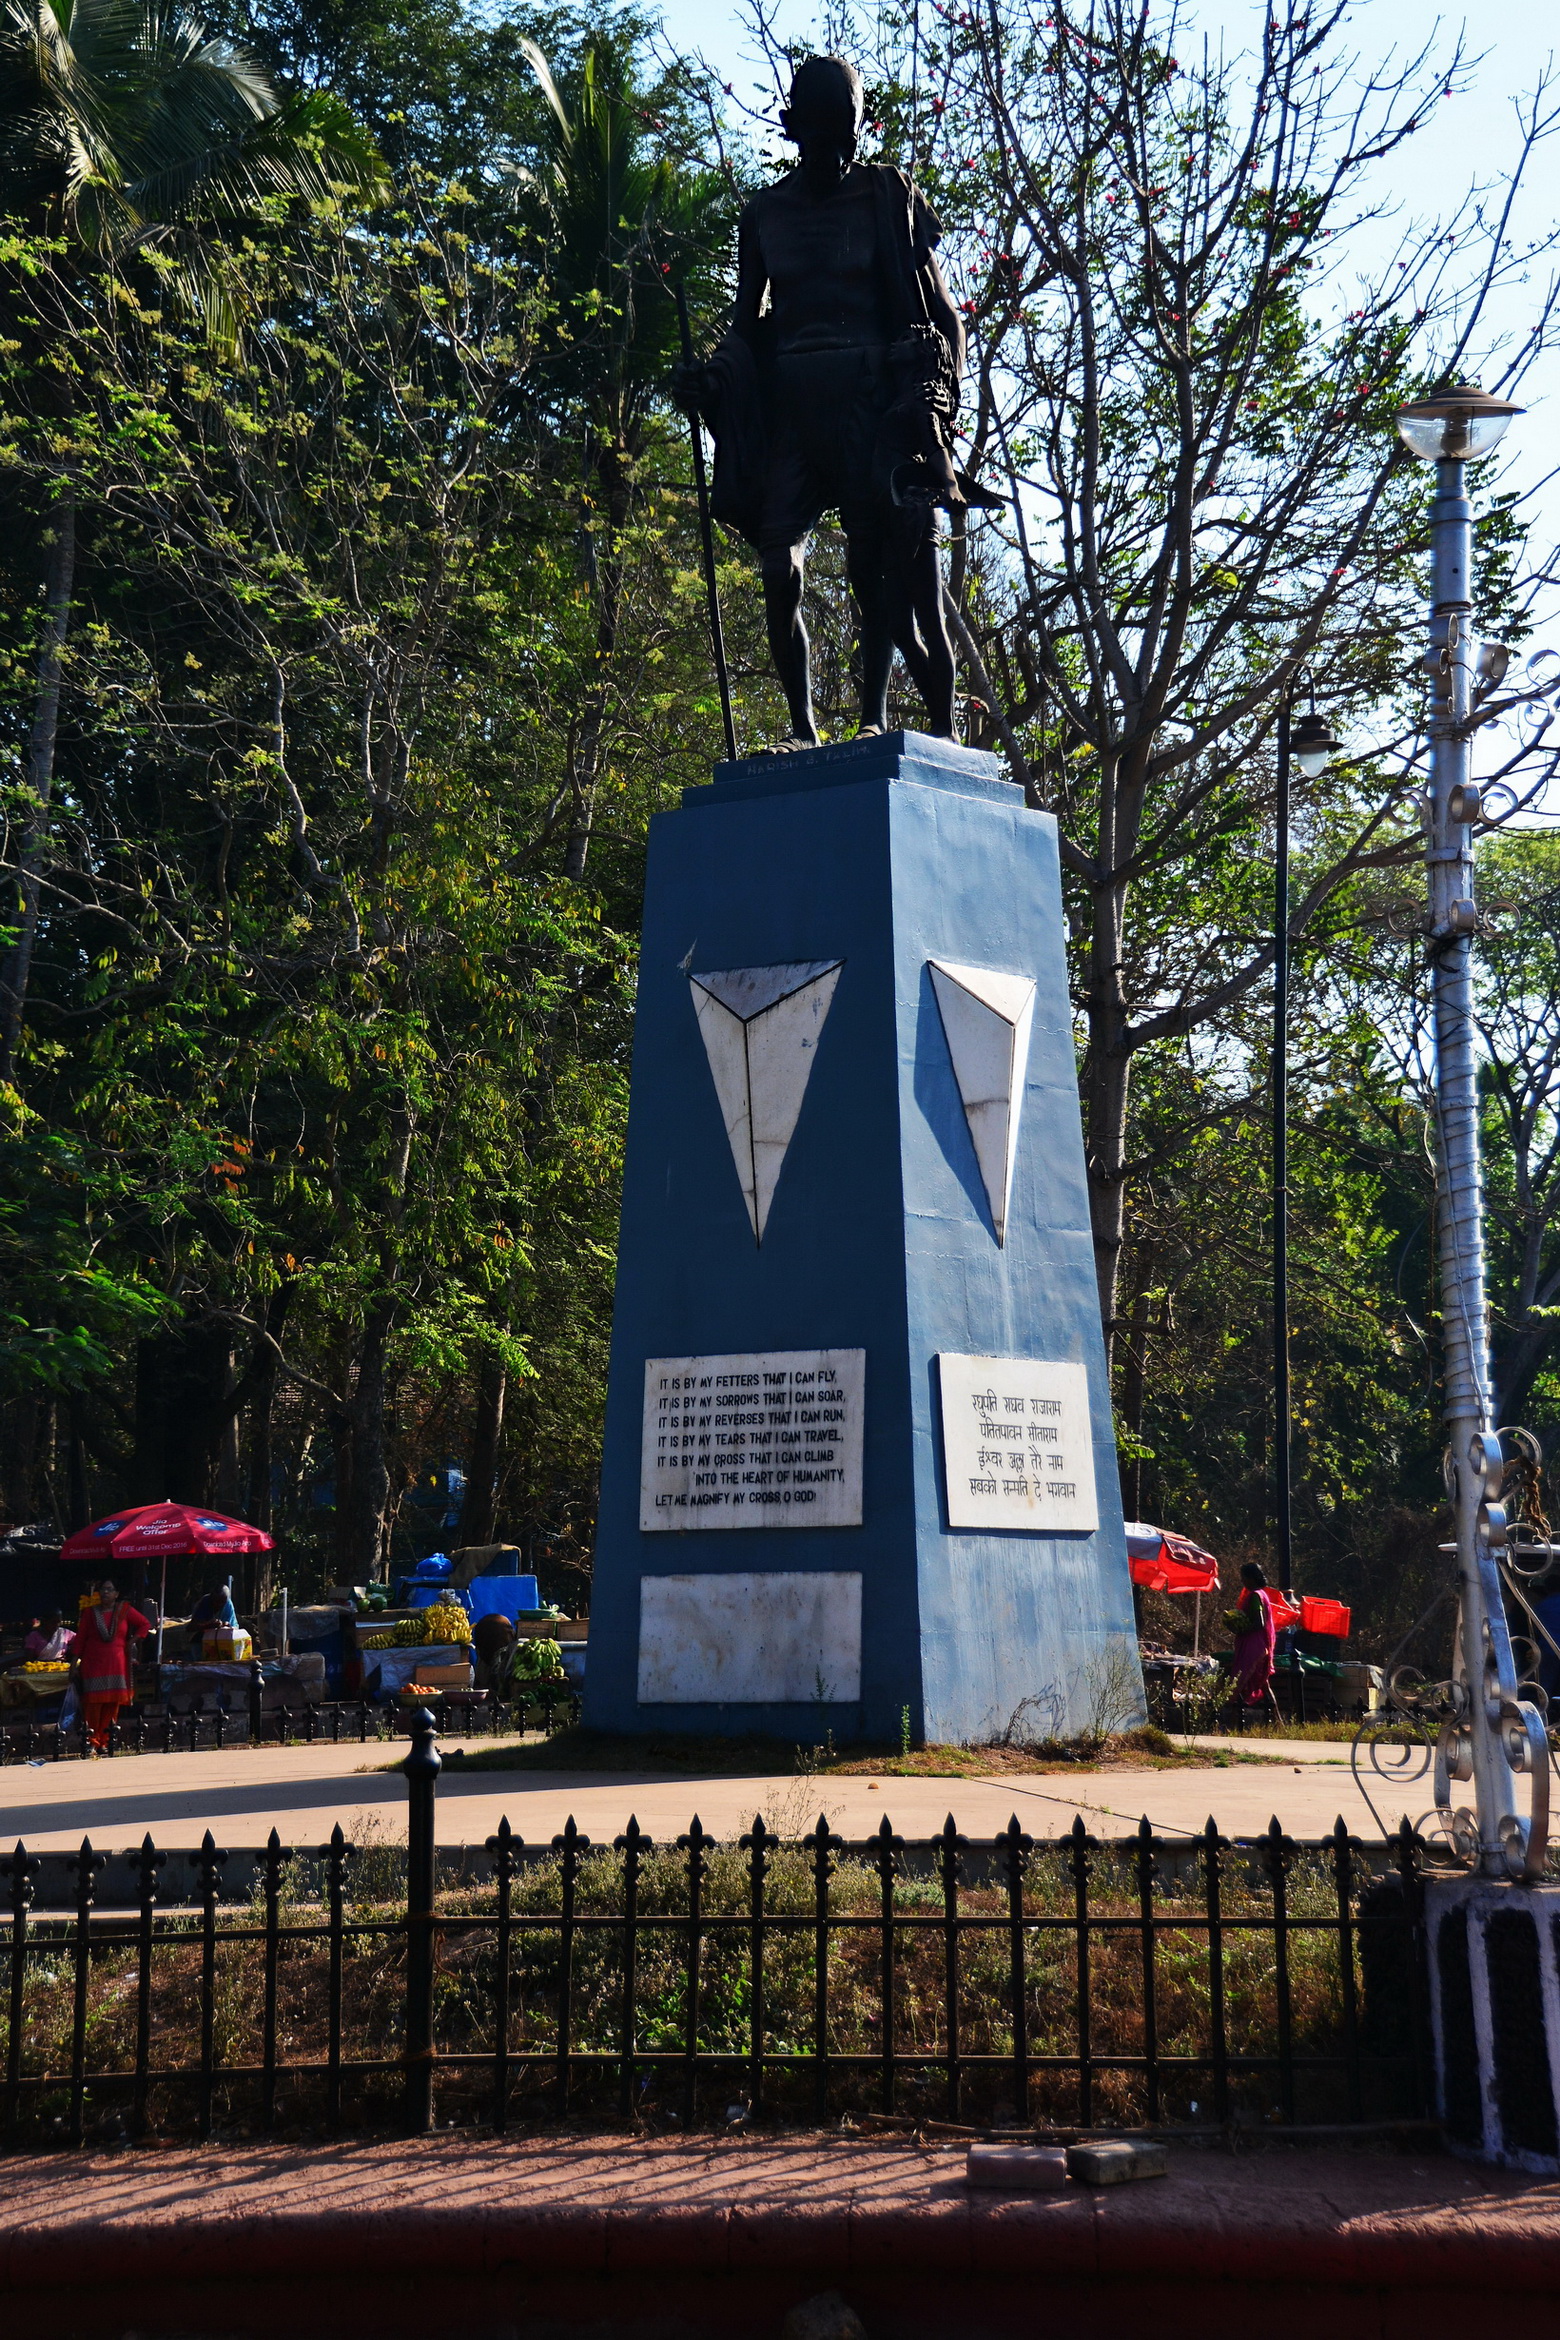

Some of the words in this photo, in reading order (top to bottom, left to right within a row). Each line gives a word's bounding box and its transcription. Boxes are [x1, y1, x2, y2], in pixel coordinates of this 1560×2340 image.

[660, 1379, 668, 1390] IT
[672, 1378, 680, 1389] IS
[684, 1377, 697, 1389] BY
[700, 1376, 713, 1388] MY
[716, 1374, 760, 1387] FETTERS
[763, 1372, 787, 1386] THAT
[789, 1372, 793, 1384] I
[795, 1371, 815, 1384] CAN
[659, 1398, 668, 1409] IT
[671, 1398, 680, 1409] IS
[683, 1397, 696, 1408] BY
[700, 1396, 712, 1407] MY
[716, 1394, 760, 1407] SORROWS
[763, 1392, 787, 1406] THAT
[789, 1391, 793, 1405] I
[795, 1391, 815, 1403] CAN
[818, 1389, 846, 1402] SOAR,
[971, 1388, 998, 1418] रघुपति
[1002, 1397, 1025, 1414] राघव
[1030, 1399, 1062, 1416] राजाराम
[658, 1417, 667, 1428] IT
[670, 1416, 679, 1428] IS
[683, 1416, 695, 1427] BY
[699, 1415, 712, 1427] MY
[715, 1412, 765, 1426] REVERSES
[768, 1411, 792, 1424] THAT
[794, 1411, 798, 1423] I
[800, 1410, 820, 1423] CAN
[823, 1409, 845, 1422] RUN,
[658, 1436, 667, 1447] IT
[670, 1436, 679, 1447] IS
[682, 1435, 695, 1446] BY
[699, 1434, 711, 1446] MY
[715, 1433, 746, 1445] TEARS
[749, 1432, 772, 1444] THAT
[775, 1432, 779, 1443] I
[781, 1430, 801, 1443] CAN
[804, 1429, 844, 1442] TRAVEL,
[979, 1416, 1022, 1440] पतितपावन
[1026, 1421, 1058, 1443] सीताराम
[657, 1456, 666, 1467] IT
[669, 1455, 678, 1467] IS
[681, 1455, 694, 1467] BY
[698, 1454, 710, 1466] MY
[714, 1453, 745, 1467] CROSS
[749, 1452, 772, 1464] THAT
[775, 1452, 779, 1463] I
[781, 1451, 801, 1463] CAN
[804, 1450, 834, 1462] CLIMB
[977, 1445, 1003, 1470] ईश्वर
[1028, 1444, 1042, 1471] तेरे
[1046, 1454, 1064, 1471] नाम
[695, 1472, 717, 1486] INTO
[720, 1472, 739, 1484] THE
[742, 1471, 774, 1484] HEART
[776, 1470, 790, 1483] OF
[792, 1468, 845, 1483] HUMANITY,
[969, 1470, 997, 1496] सबको
[1002, 1475, 1028, 1496] सन्मति
[1033, 1473, 1042, 1502] दे
[1046, 1482, 1076, 1499] भगवान
[655, 1494, 673, 1507] LET
[674, 1494, 687, 1506] ME
[690, 1492, 730, 1507] MAGNIFY
[733, 1492, 745, 1504] MY
[783, 1490, 791, 1502] O
[98, 1522, 120, 1532] Jio
[135, 1522, 182, 1531] Welcome
[119, 1545, 135, 1553] FREE
